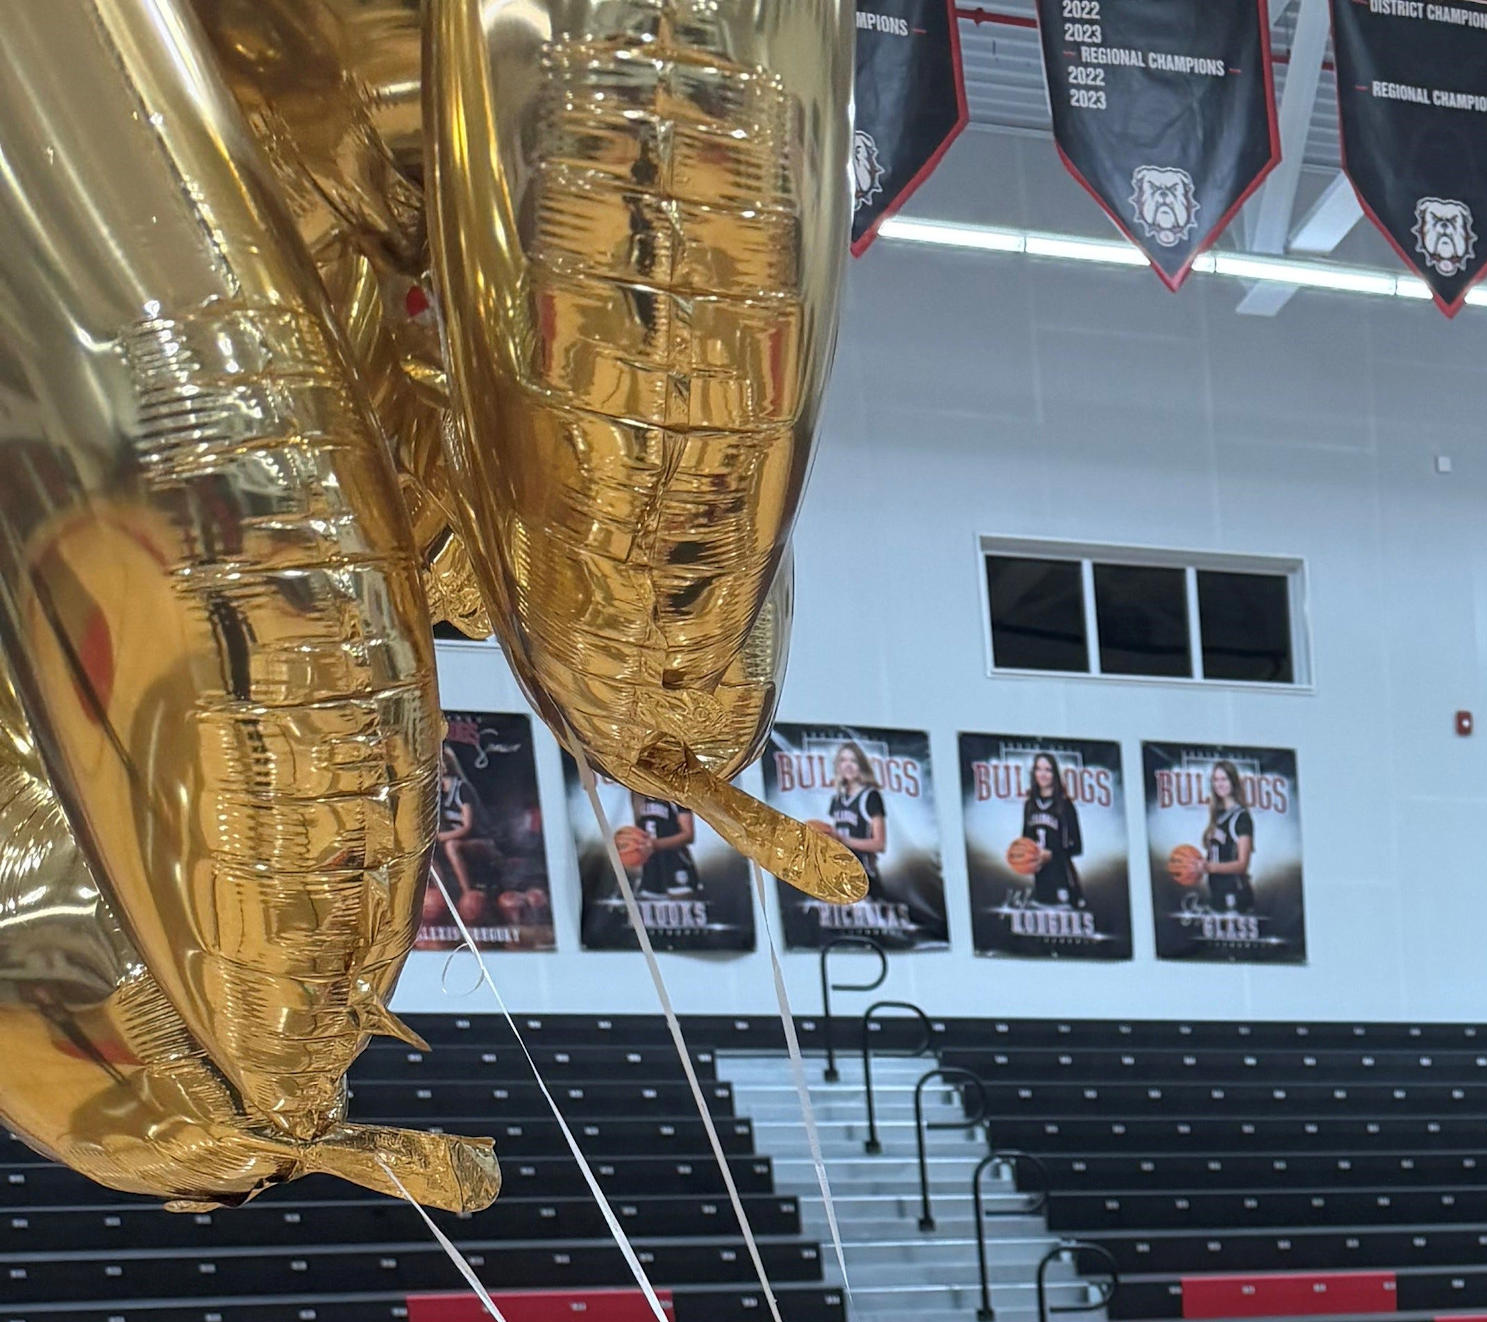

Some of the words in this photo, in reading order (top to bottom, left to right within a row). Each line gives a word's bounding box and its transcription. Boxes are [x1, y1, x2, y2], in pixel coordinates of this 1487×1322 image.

[1062, 0, 1101, 19] 2022
[1370, 0, 1424, 18] DISTRICT
[856, 11, 909, 36] MPIONS
[1064, 23, 1102, 43] 2023
[1081, 46, 1146, 68] REGIONAL
[1148, 52, 1225, 76] CHAMPIONS
[1068, 66, 1105, 86] 2022
[1070, 89, 1107, 110] 2023
[1372, 80, 1430, 104] REGIONAL
[774, 753, 920, 797] BULOGS
[973, 762, 1112, 807] BULOGS
[1156, 771, 1287, 814] BULOGS
